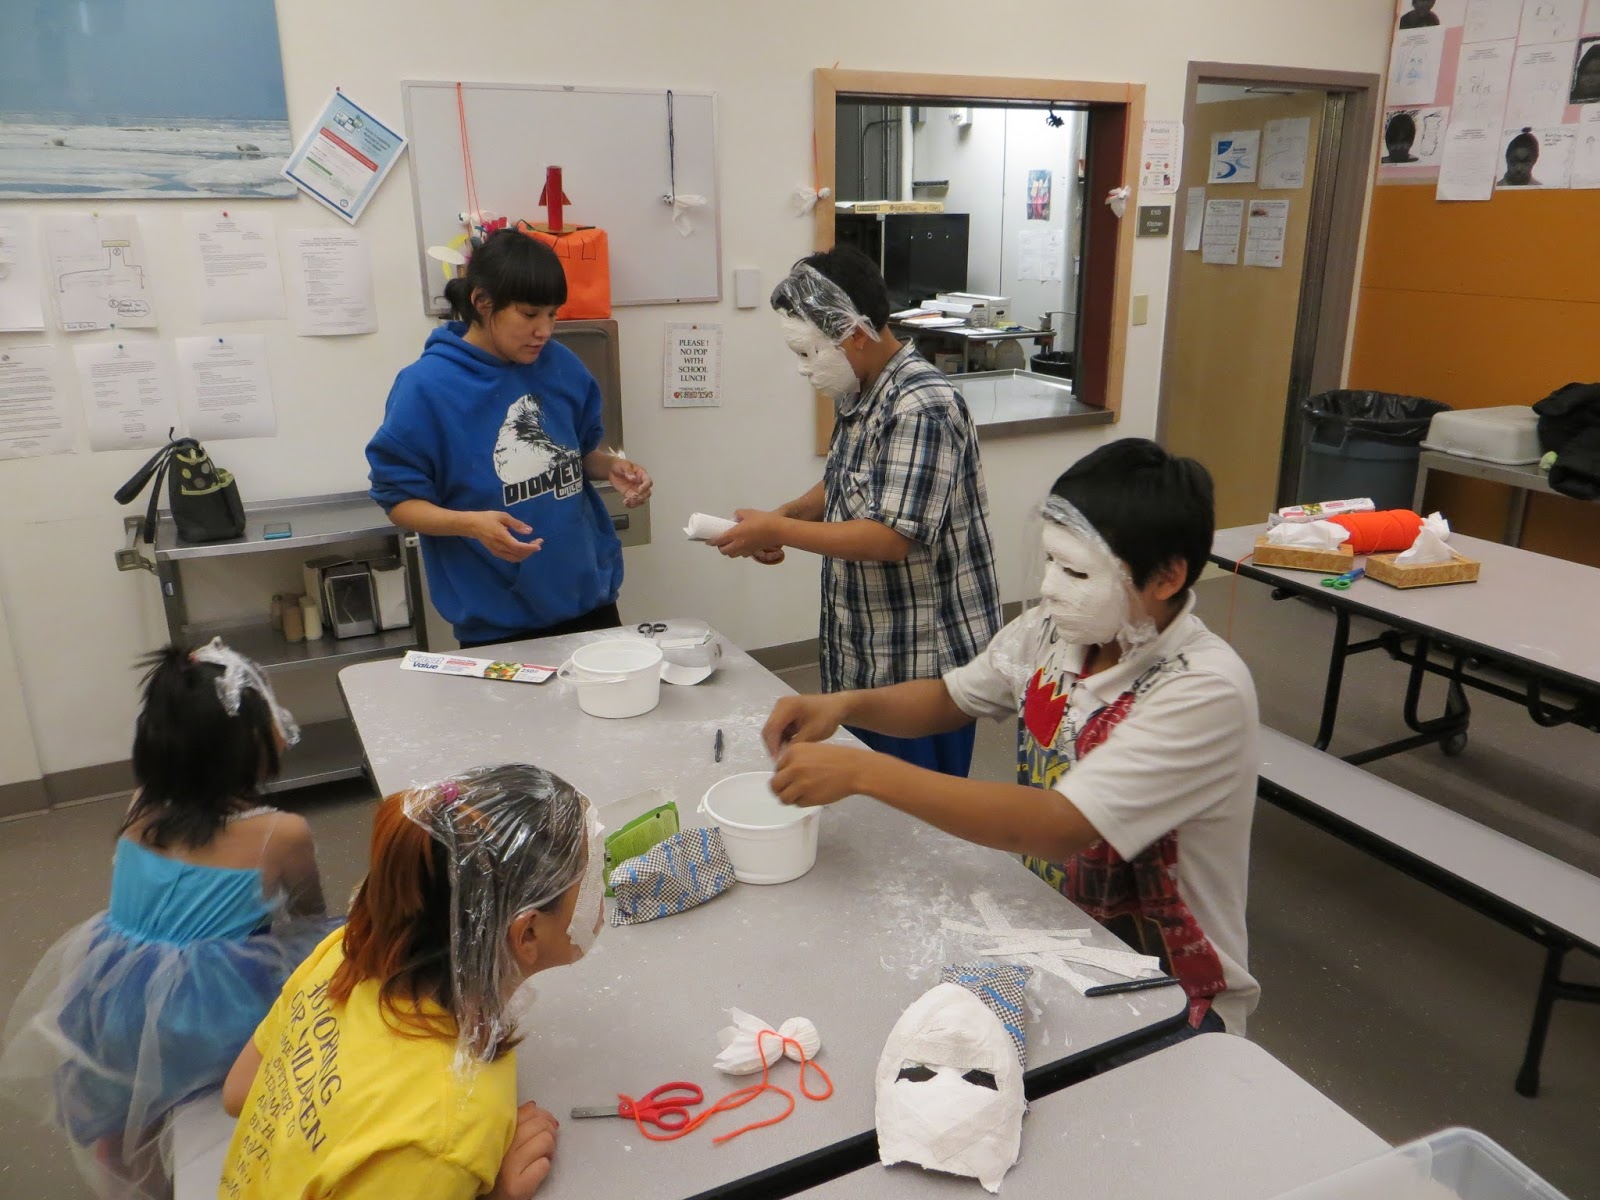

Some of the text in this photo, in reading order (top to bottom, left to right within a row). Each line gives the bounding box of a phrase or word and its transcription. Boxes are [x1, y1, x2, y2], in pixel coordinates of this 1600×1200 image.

[680, 374, 706, 382] LUNCH
[503, 457, 583, 507] DIOMED
[409, 653, 444, 665] Great
[413, 661, 438, 669] Value
